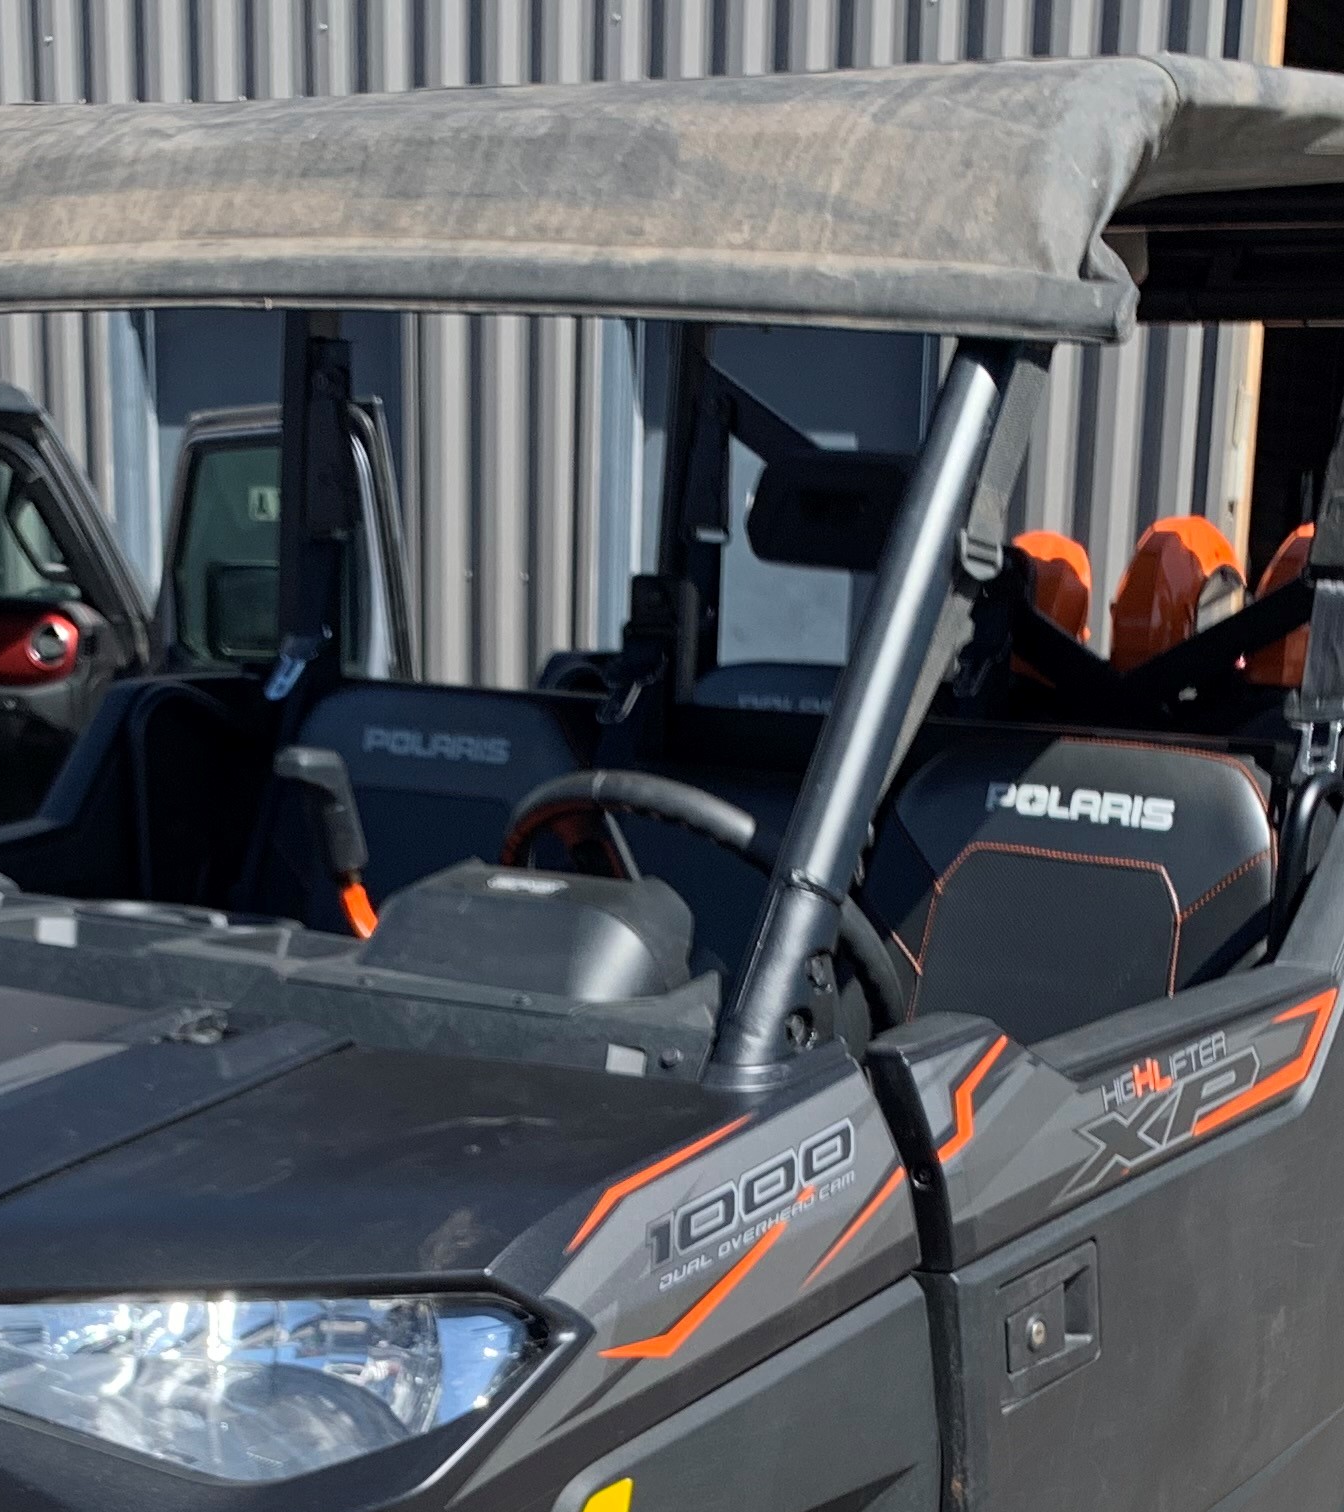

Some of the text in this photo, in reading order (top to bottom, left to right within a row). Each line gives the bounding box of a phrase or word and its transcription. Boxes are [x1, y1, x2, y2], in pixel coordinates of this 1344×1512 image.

[363, 726, 510, 764] POLARIS
[985, 782, 1175, 832] POLARIS
[1054, 1046, 1260, 1198] XP
[644, 1118, 855, 1268] 1000
[659, 1249, 713, 1292] DUAL
[717, 1192, 816, 1259] OVERHEAD
